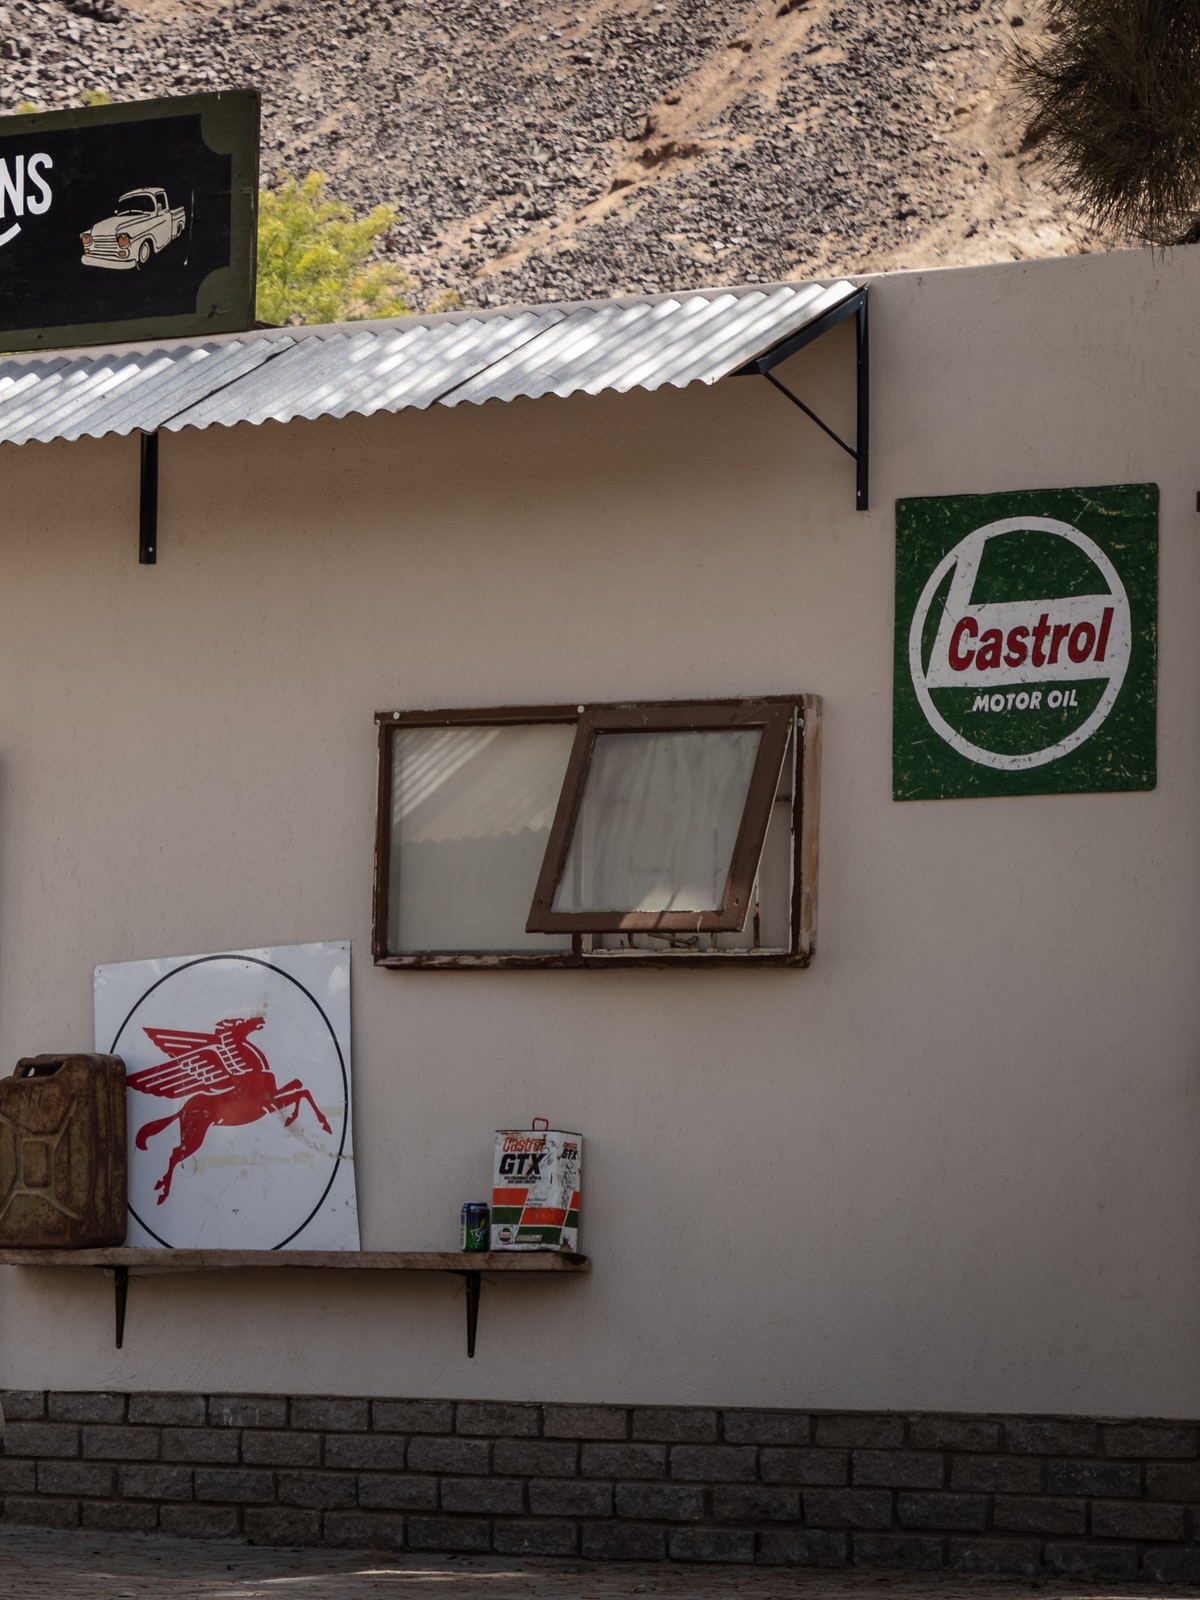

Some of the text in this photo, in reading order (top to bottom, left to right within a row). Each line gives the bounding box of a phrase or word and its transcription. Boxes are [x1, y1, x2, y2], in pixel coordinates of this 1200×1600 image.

[948, 607, 1115, 671] Castrol
[972, 689, 1078, 712] MOTOR OIL
[502, 1135, 546, 1153] Castrol
[561, 1148, 578, 1160] GTX
[499, 1153, 548, 1175] GTX
